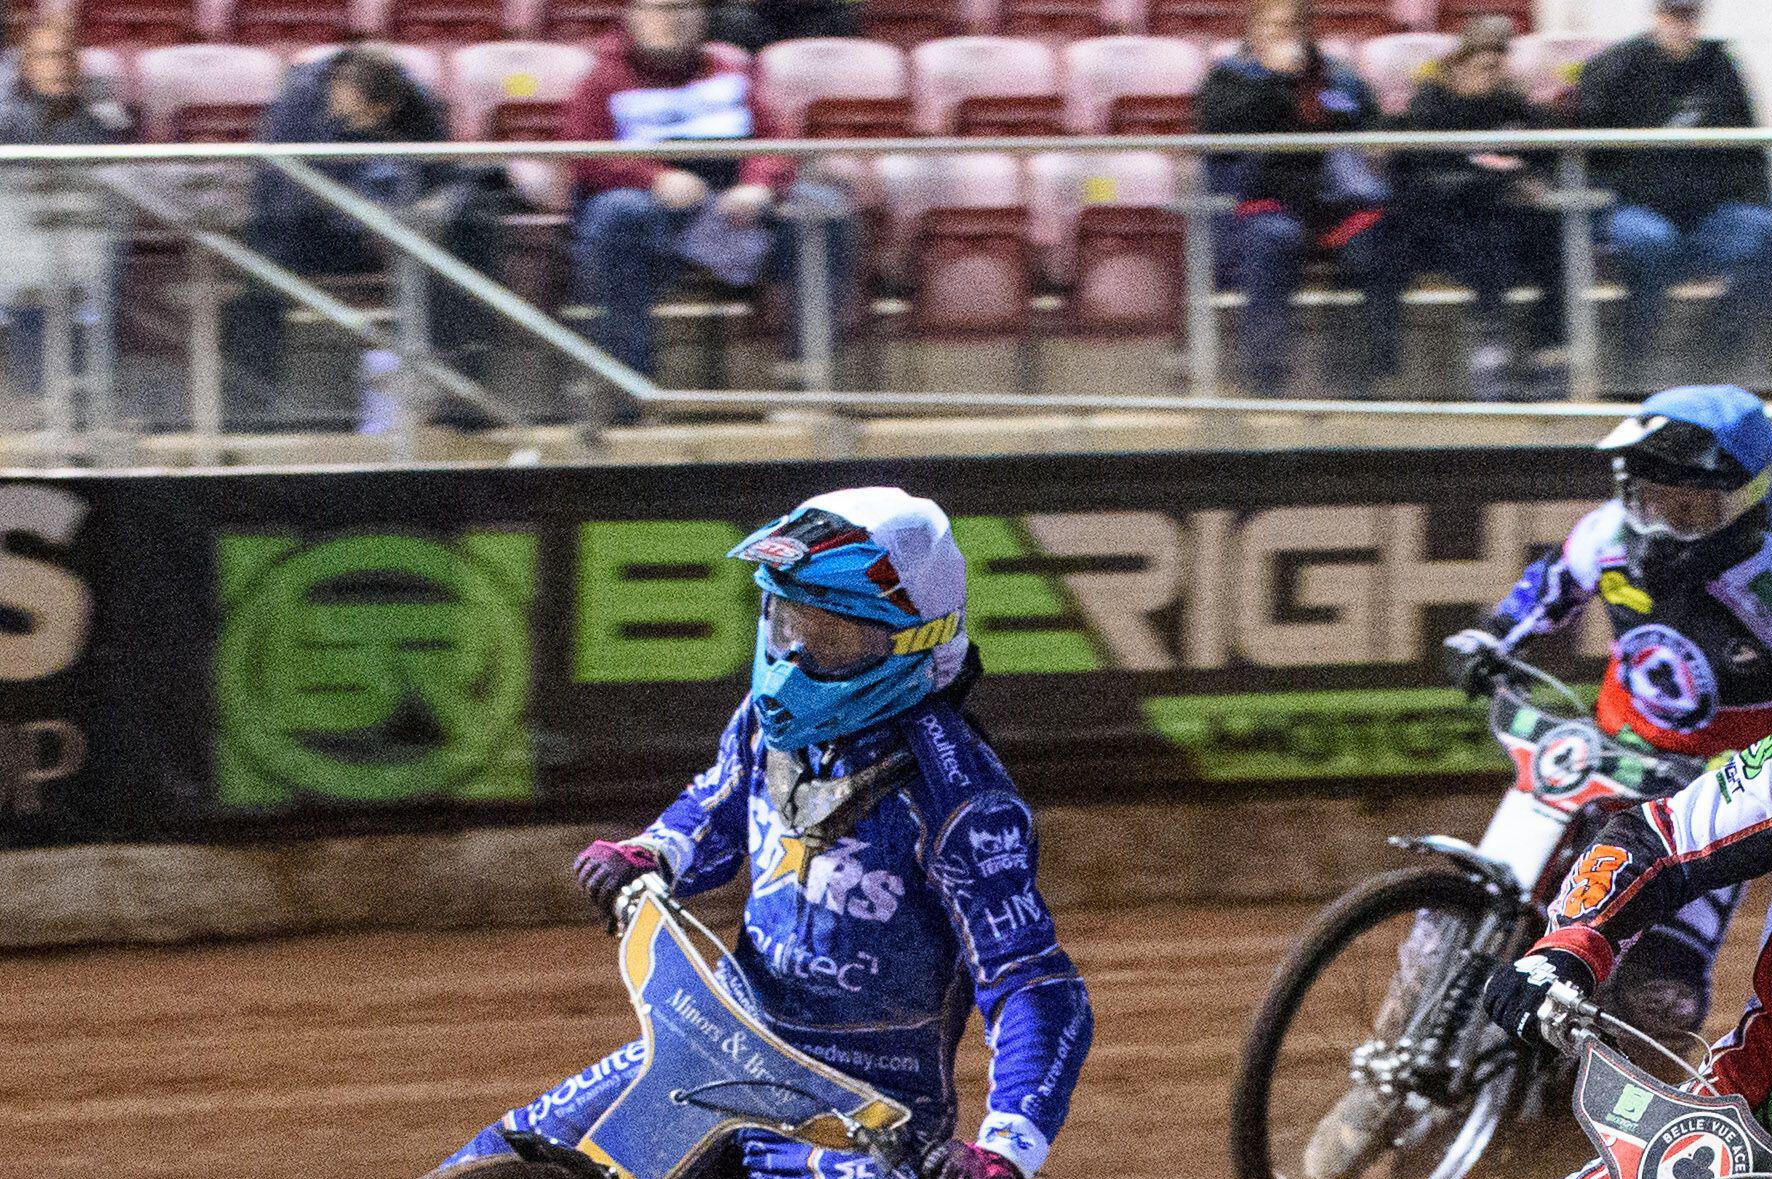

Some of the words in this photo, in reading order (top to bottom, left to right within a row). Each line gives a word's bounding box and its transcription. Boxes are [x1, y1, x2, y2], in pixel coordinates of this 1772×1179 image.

[665, 988, 722, 1047] Minors
[720, 1031, 751, 1064] &
[1663, 1118, 1705, 1144] BELLE
[1711, 1120, 1737, 1143] VUE
[1731, 1144, 1747, 1173] ACE
